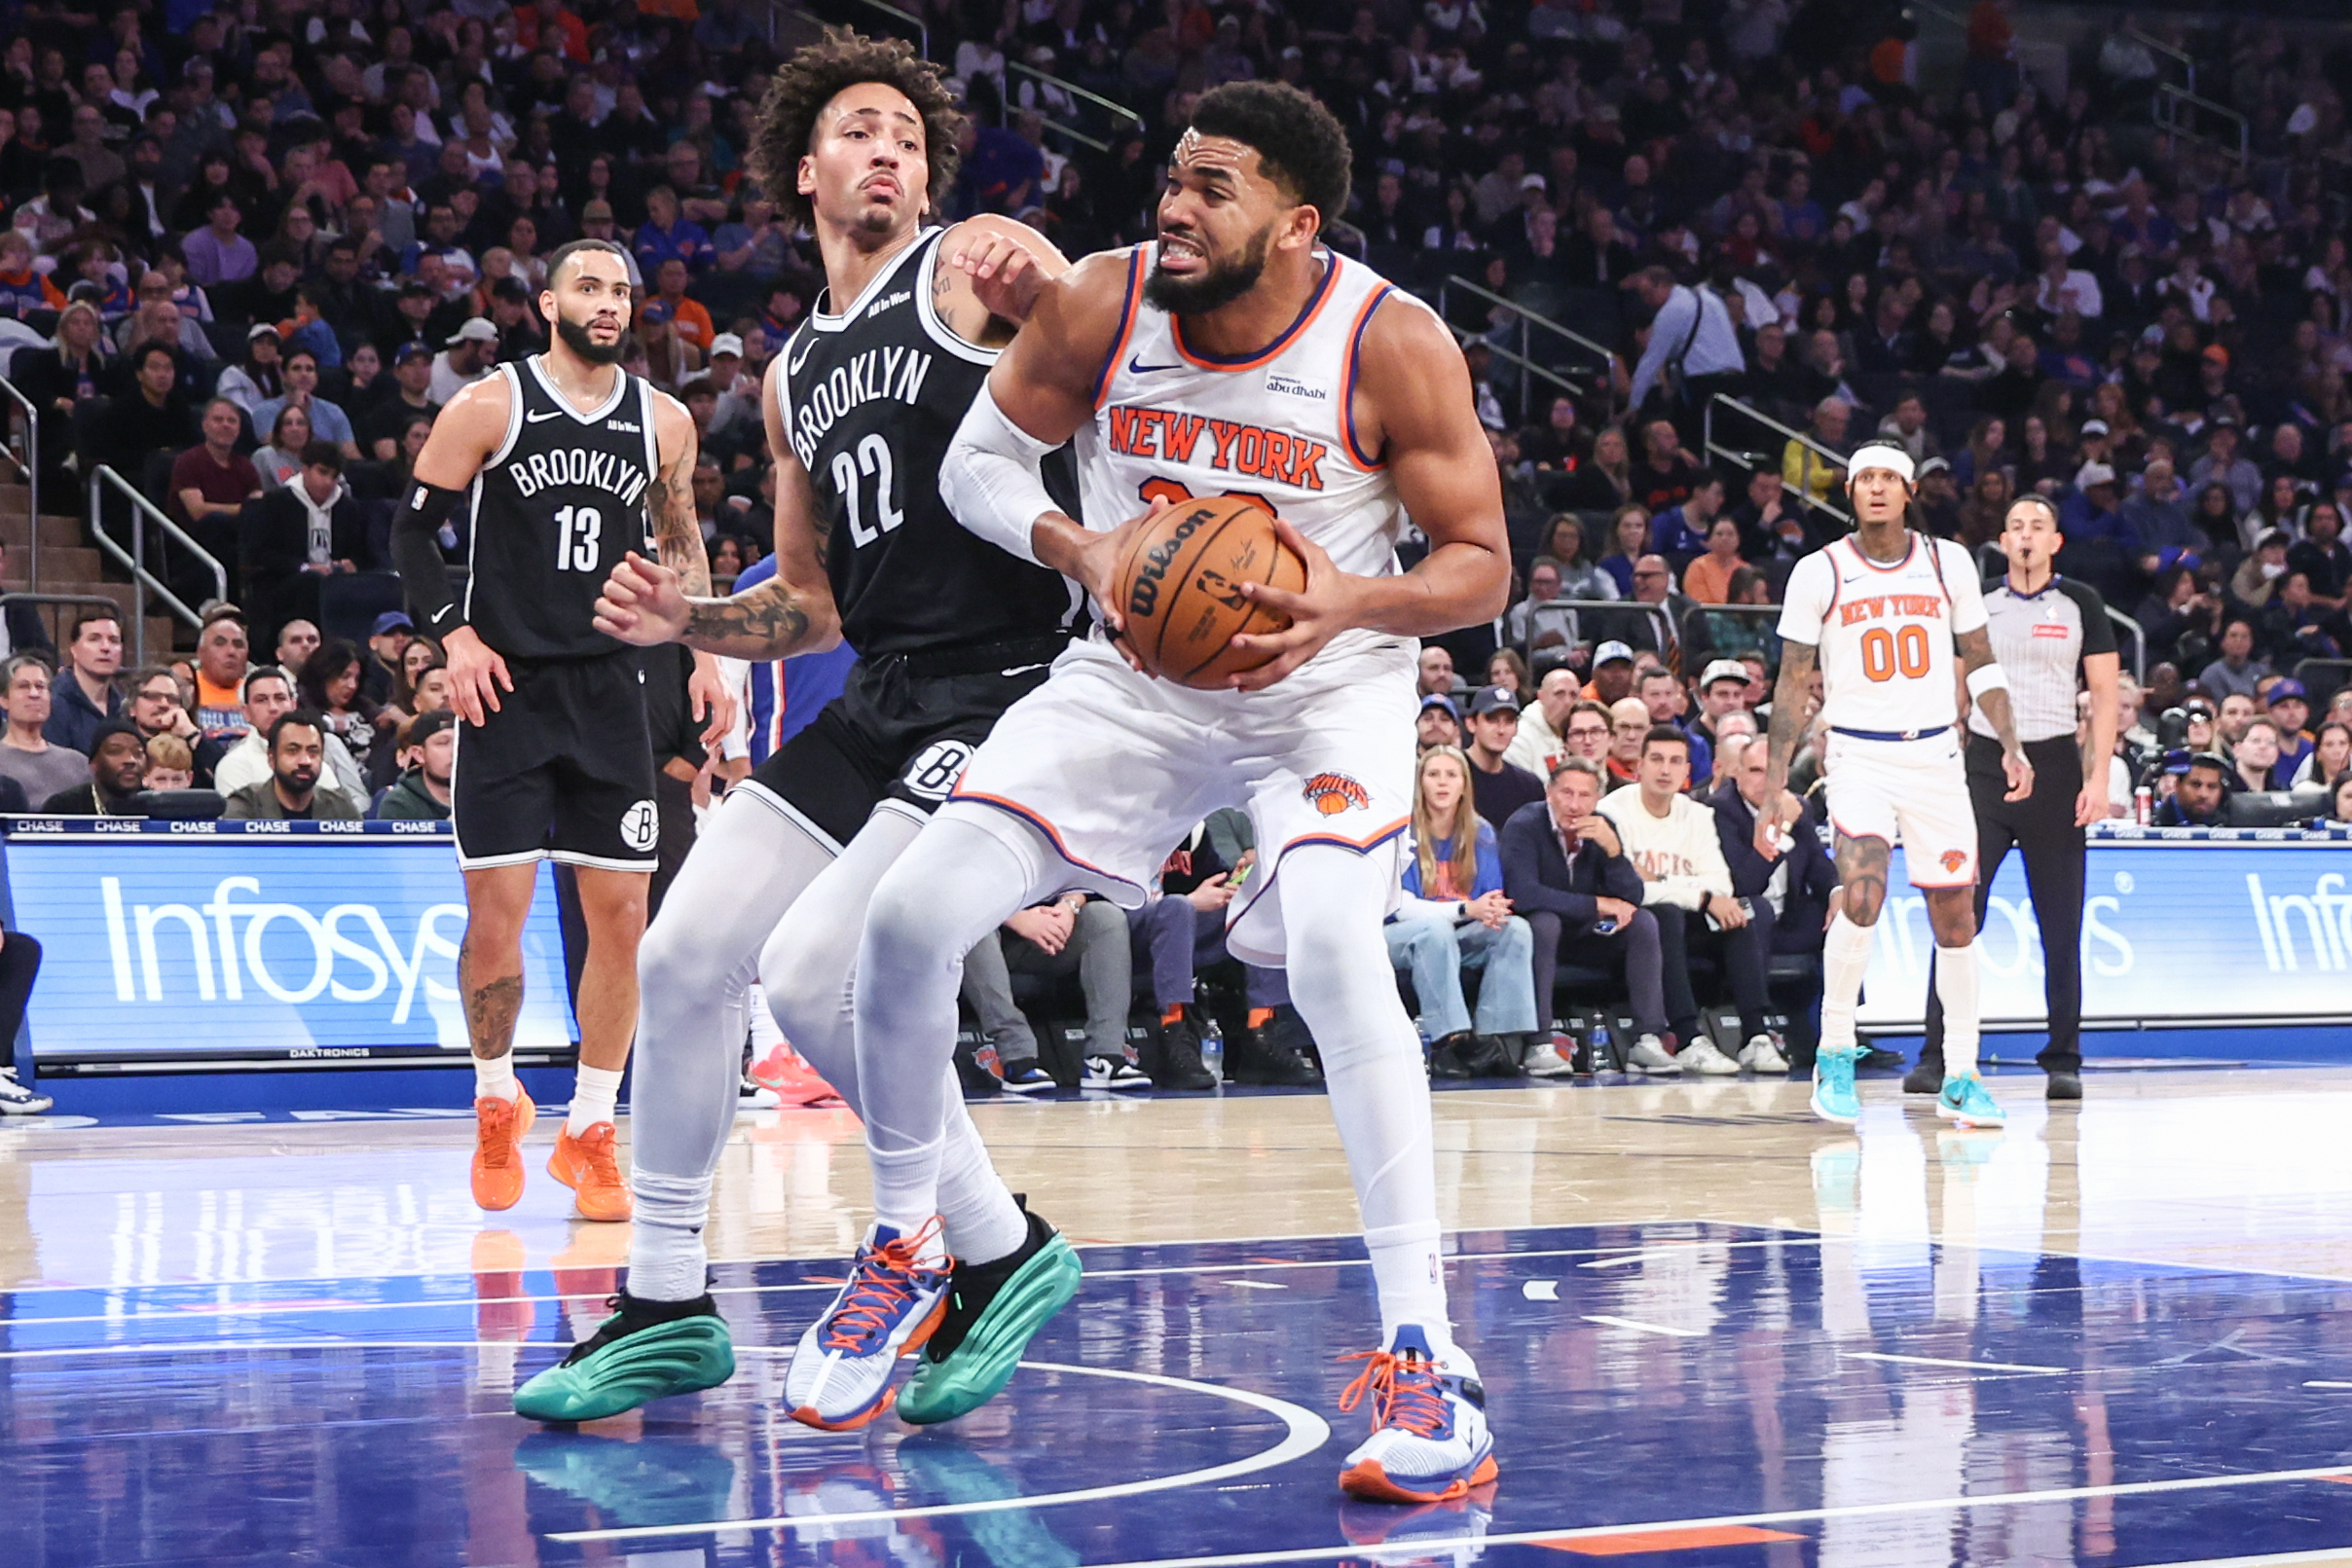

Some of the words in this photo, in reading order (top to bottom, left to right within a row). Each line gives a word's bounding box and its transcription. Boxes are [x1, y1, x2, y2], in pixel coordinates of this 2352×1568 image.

[868, 302, 880, 318] All
[881, 299, 890, 311] In
[890, 291, 911, 307] Won
[1267, 382, 1290, 393] abu
[1291, 385, 1327, 400] dhabi
[796, 346, 932, 472] BROOKLYN
[1109, 405, 1204, 463] NEW
[1209, 419, 1327, 492] YORK
[509, 448, 647, 507] BROOKLYN
[831, 433, 904, 549] 22
[554, 505, 602, 572] 13
[1130, 508, 1218, 617] Wilson
[1840, 596, 1886, 627] NEW
[1888, 594, 1941, 619] YORK
[1860, 624, 1930, 682] 00
[17, 820, 64, 832] CHASE
[94, 820, 141, 832] CHASE
[170, 821, 217, 833] CHASE
[245, 820, 290, 833] CHASE
[318, 820, 364, 833] CHASE
[391, 821, 436, 833] CHASE
[2245, 872, 2352, 972] Inf
[289, 1047, 370, 1058] DAKTRONICS
